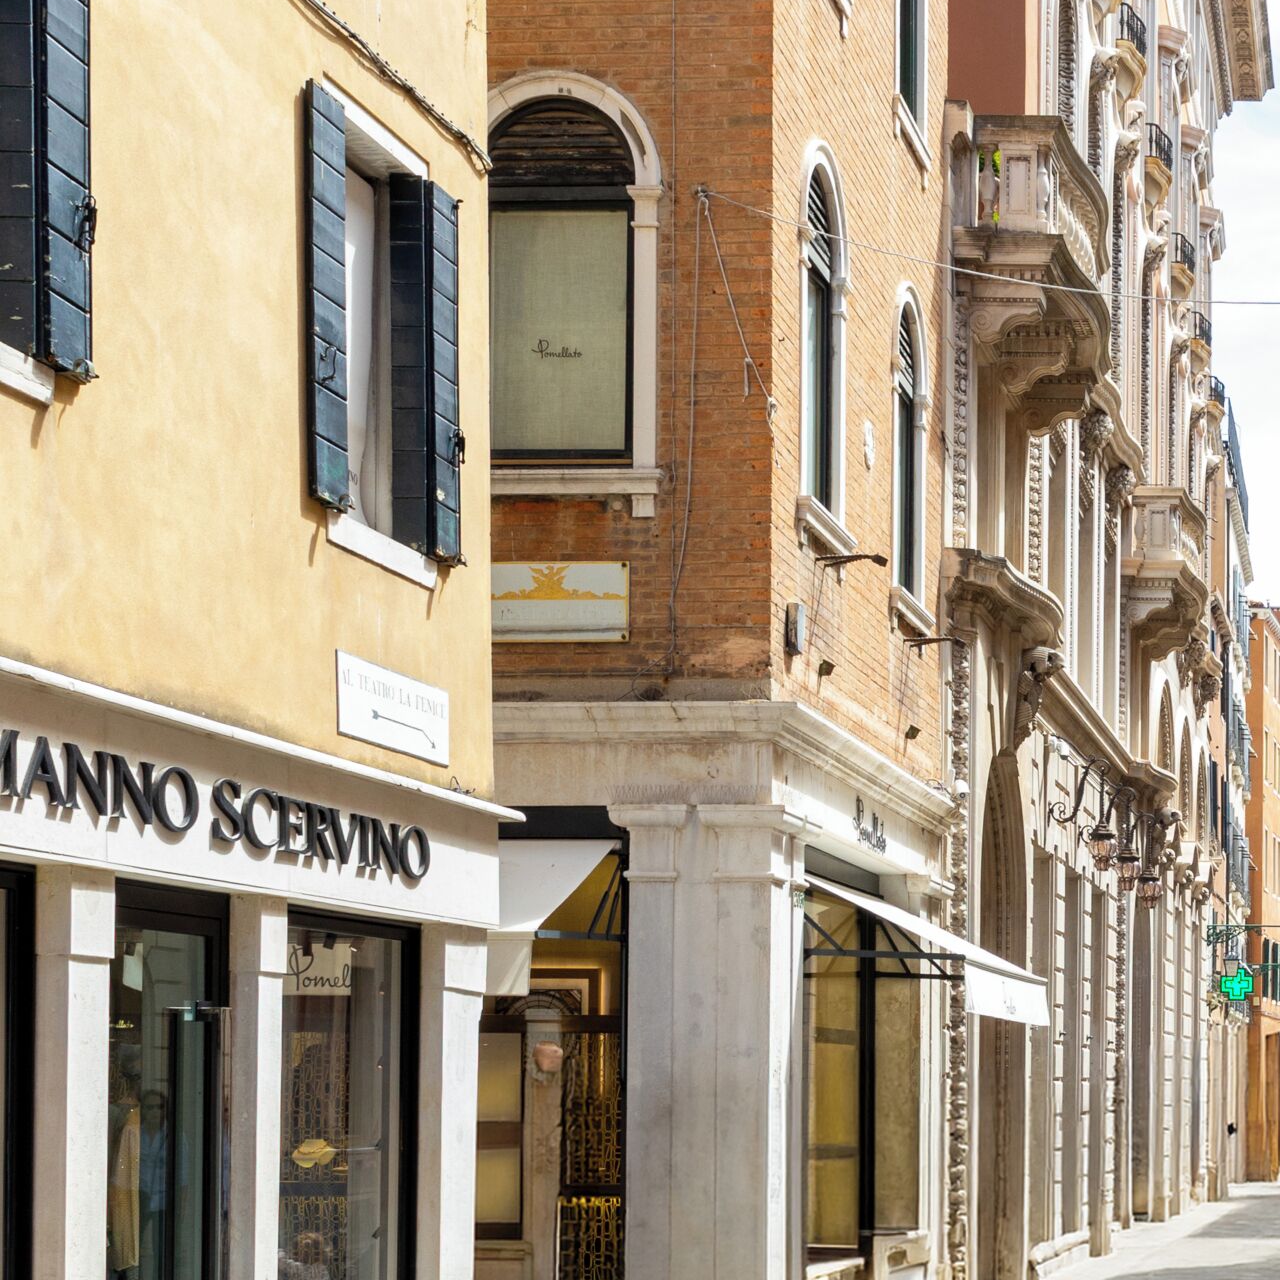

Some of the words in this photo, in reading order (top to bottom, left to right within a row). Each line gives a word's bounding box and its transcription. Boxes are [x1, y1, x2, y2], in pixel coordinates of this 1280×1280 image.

[531, 339, 582, 359] Pomellato
[342, 668, 354, 687] AL
[358, 673, 395, 701] TEATRO
[399, 688, 411, 708] LA
[415, 694, 447, 719] FENICE
[211, 777, 430, 880] SCERVINO
